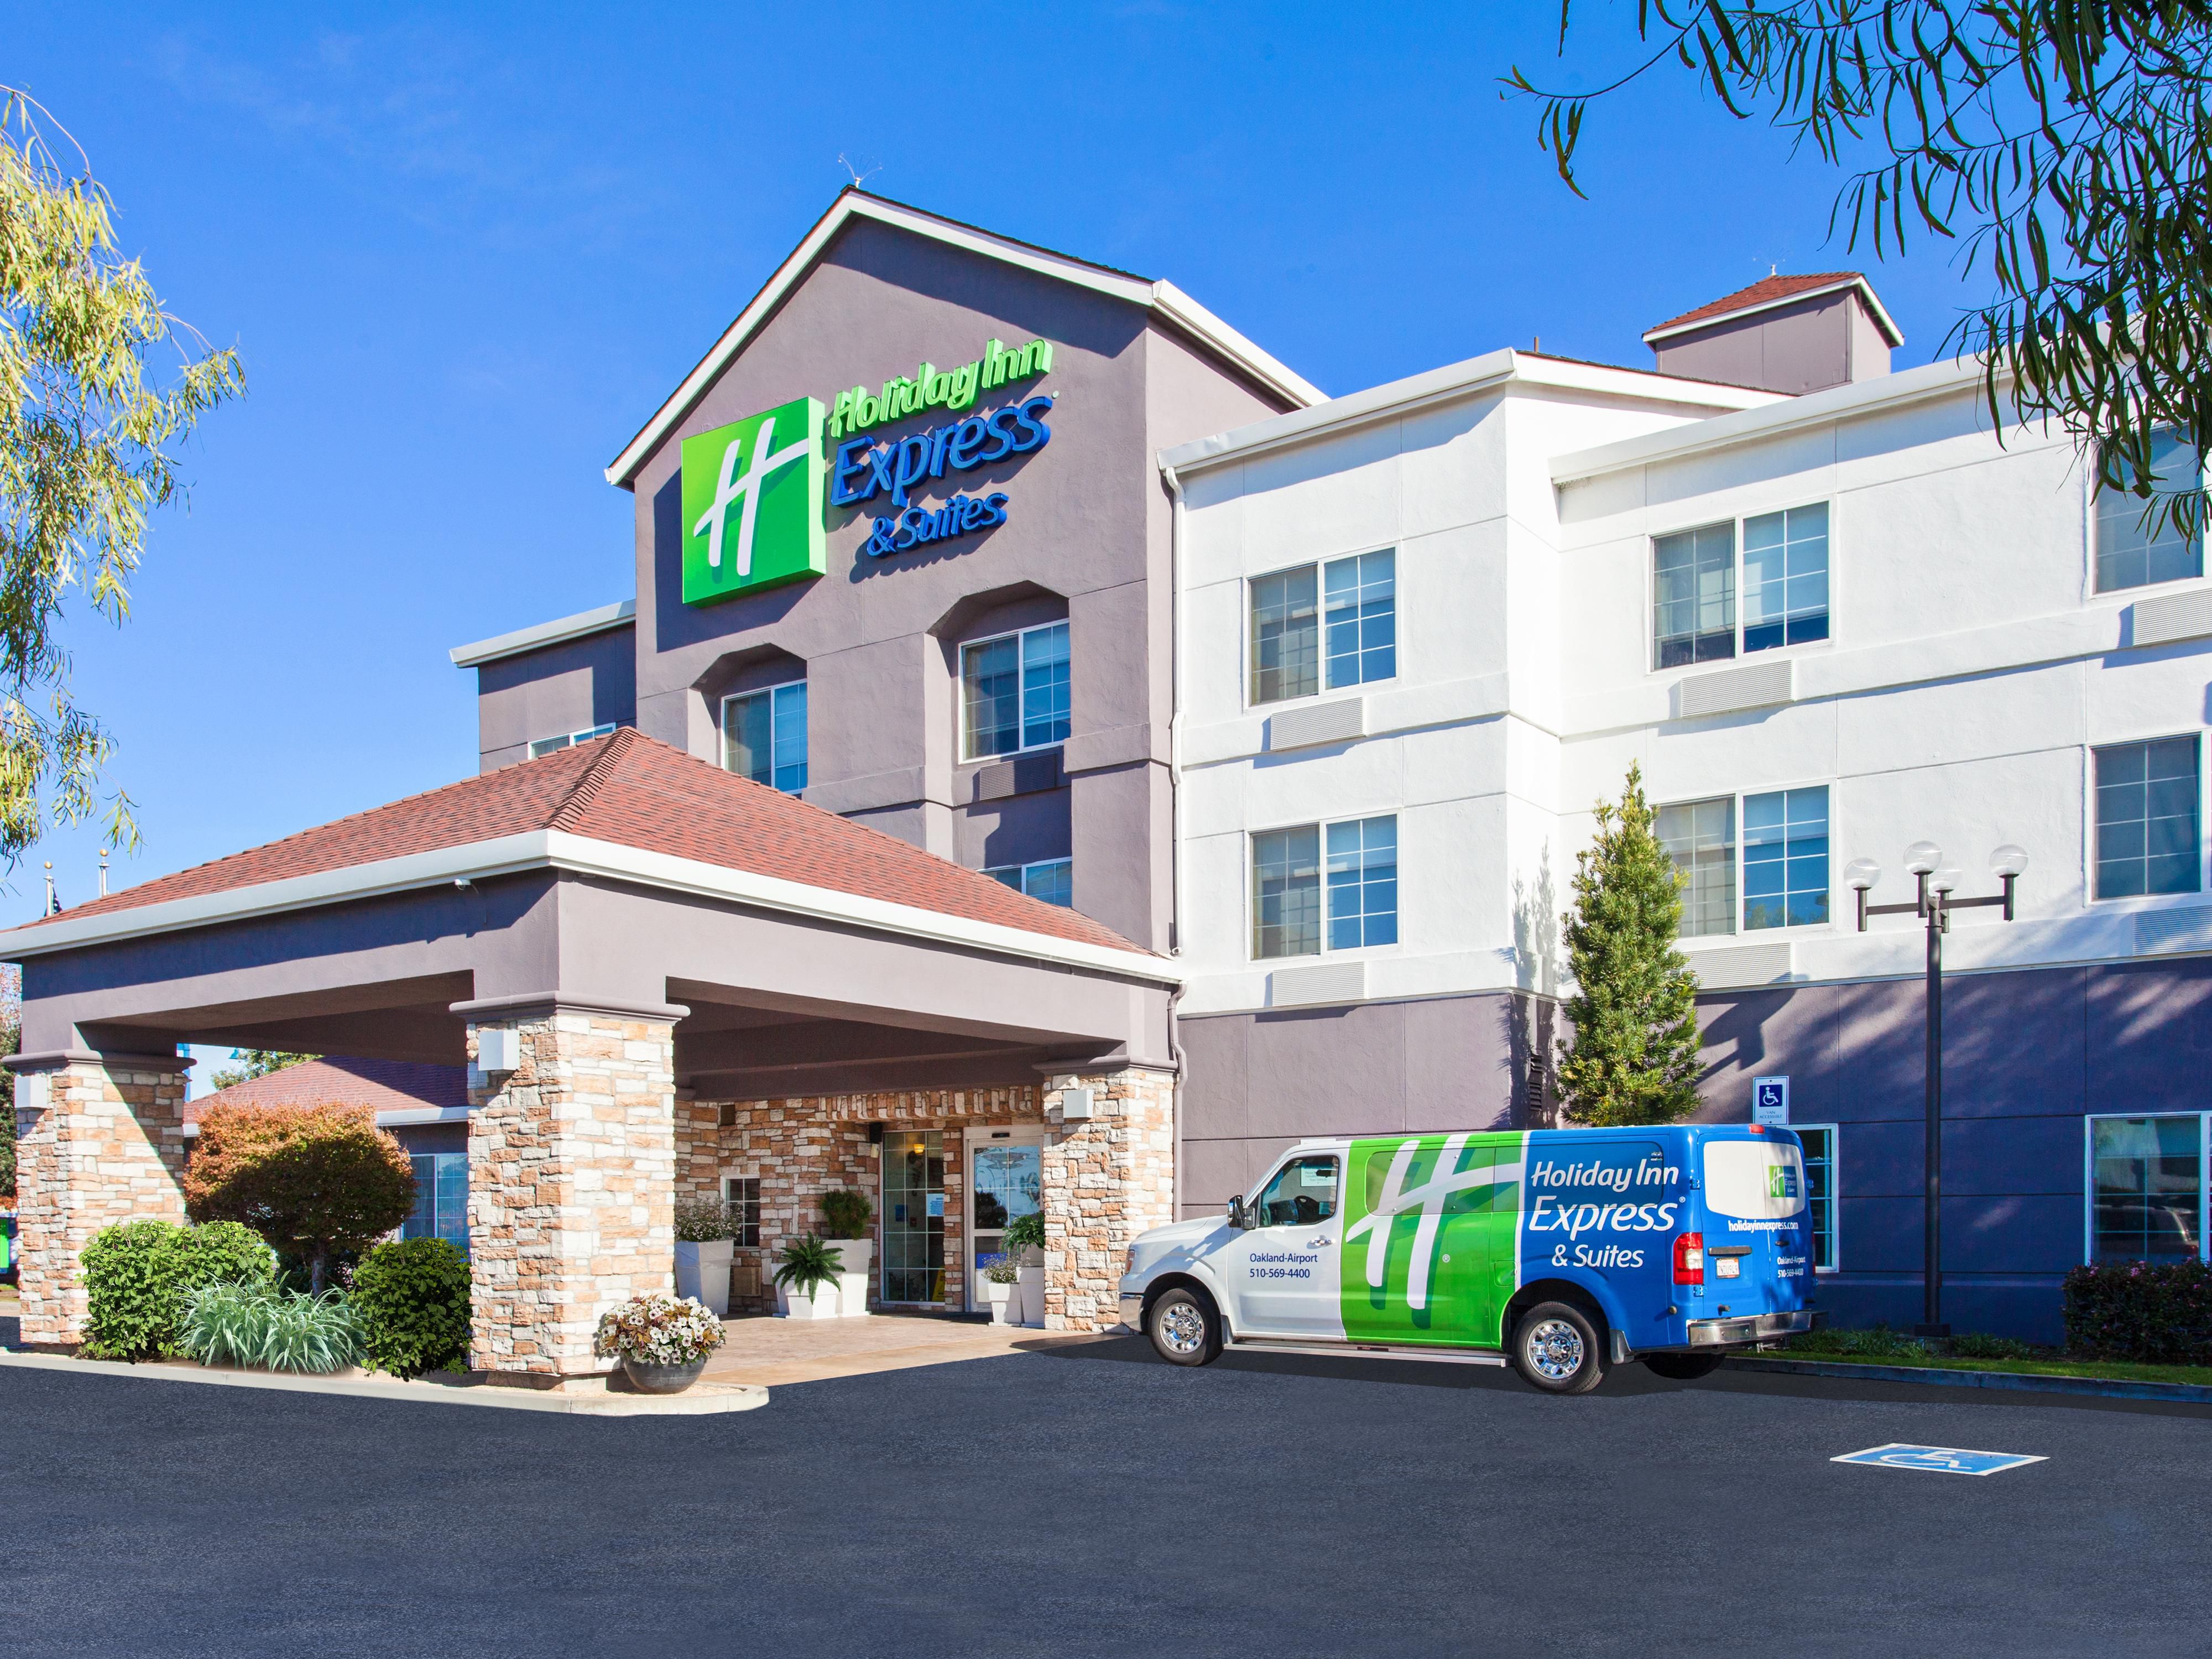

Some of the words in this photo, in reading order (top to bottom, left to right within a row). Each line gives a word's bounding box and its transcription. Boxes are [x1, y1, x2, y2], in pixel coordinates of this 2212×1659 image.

[828, 361, 979, 440] Holiday
[982, 338, 1053, 389] Inn
[831, 396, 1052, 508] Express
[867, 517, 896, 557] &
[898, 492, 1009, 549] Suites
[1531, 1161, 1633, 1193] Holiday
[1635, 1159, 1679, 1186] Inn
[1528, 1195, 1678, 1241] Express
[1728, 1220, 1798, 1234] holidayinnexpress.com
[1250, 1253, 1318, 1265] Oakland-Airport
[1552, 1244, 1568, 1267] &
[1573, 1244, 1645, 1267] Suites
[1777, 1256, 1806, 1265] Oakland-Airport
[1250, 1269, 1310, 1278] 510-569-4400
[1778, 1268, 1804, 1278] 510-569-4400
